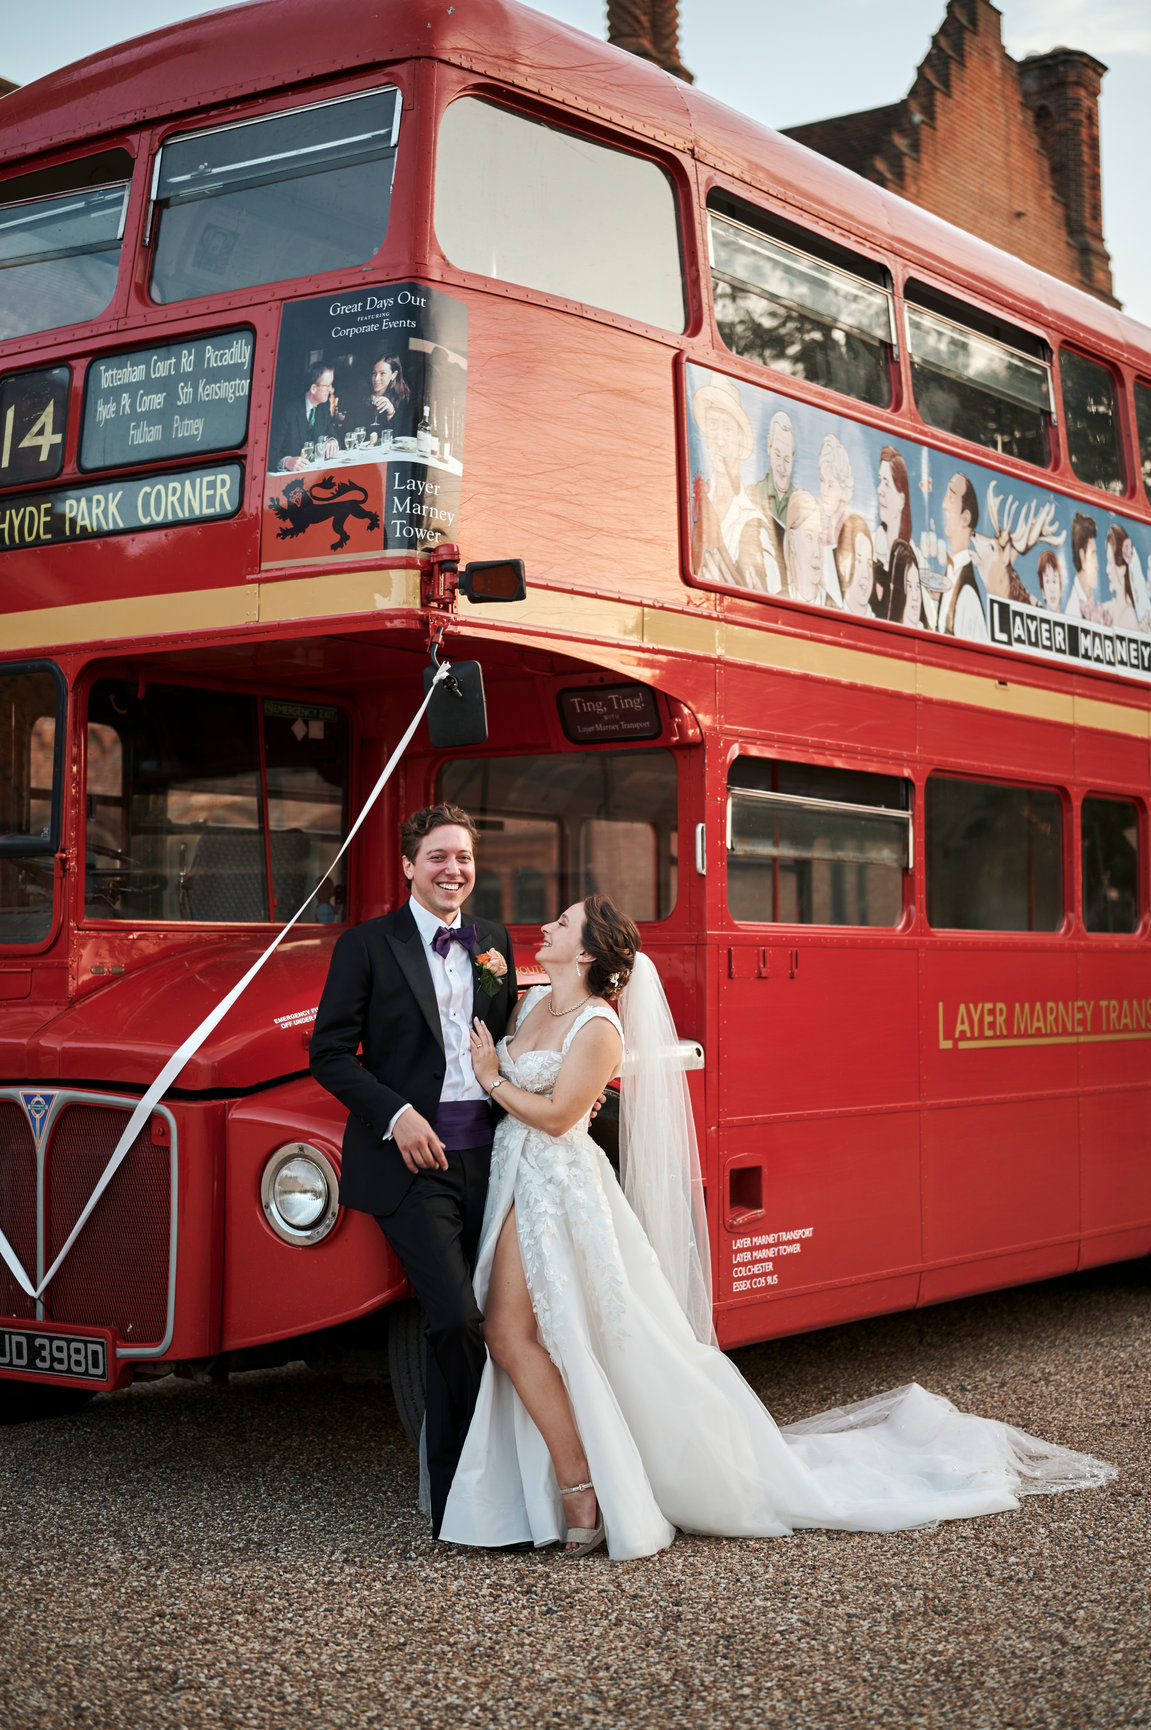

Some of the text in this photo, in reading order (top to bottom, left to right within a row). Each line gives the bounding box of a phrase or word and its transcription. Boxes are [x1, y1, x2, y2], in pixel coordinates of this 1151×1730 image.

[329, 290, 427, 317] Great Days Out
[331, 317, 417, 338] Corporate Events
[357, 311, 390, 321] FEATURING
[100, 339, 251, 389] Tottenham Court Rd Piccadilly
[96, 378, 251, 427] Hyde Pk Corner Sth Kensington
[1, 398, 63, 469] 14
[128, 415, 205, 446] Fulham Putney
[393, 472, 441, 496] Layer
[0, 474, 231, 545] HYDE PARK CORNER
[392, 496, 455, 526] Marney
[391, 520, 441, 544] Tower
[993, 602, 1151, 667] LAYER MARNEY
[570, 692, 645, 714] Ting, Ting!
[577, 721, 650, 734] Layer Marney Transport
[273, 1009, 310, 1025] EMERGENCY
[280, 1020, 293, 1029] OFF
[293, 1015, 314, 1026] UNDER
[938, 1001, 1008, 1049] LAYER
[1013, 1000, 1095, 1036] MARNEY
[732, 1227, 814, 1250] LAYER MARNEY TRANSPORT
[732, 1243, 801, 1264] LAYER MARNEY TOWER
[732, 1261, 773, 1278] COLCHESTER
[732, 1279, 751, 1292] ESSEX
[34, 1338, 104, 1375] 398D
